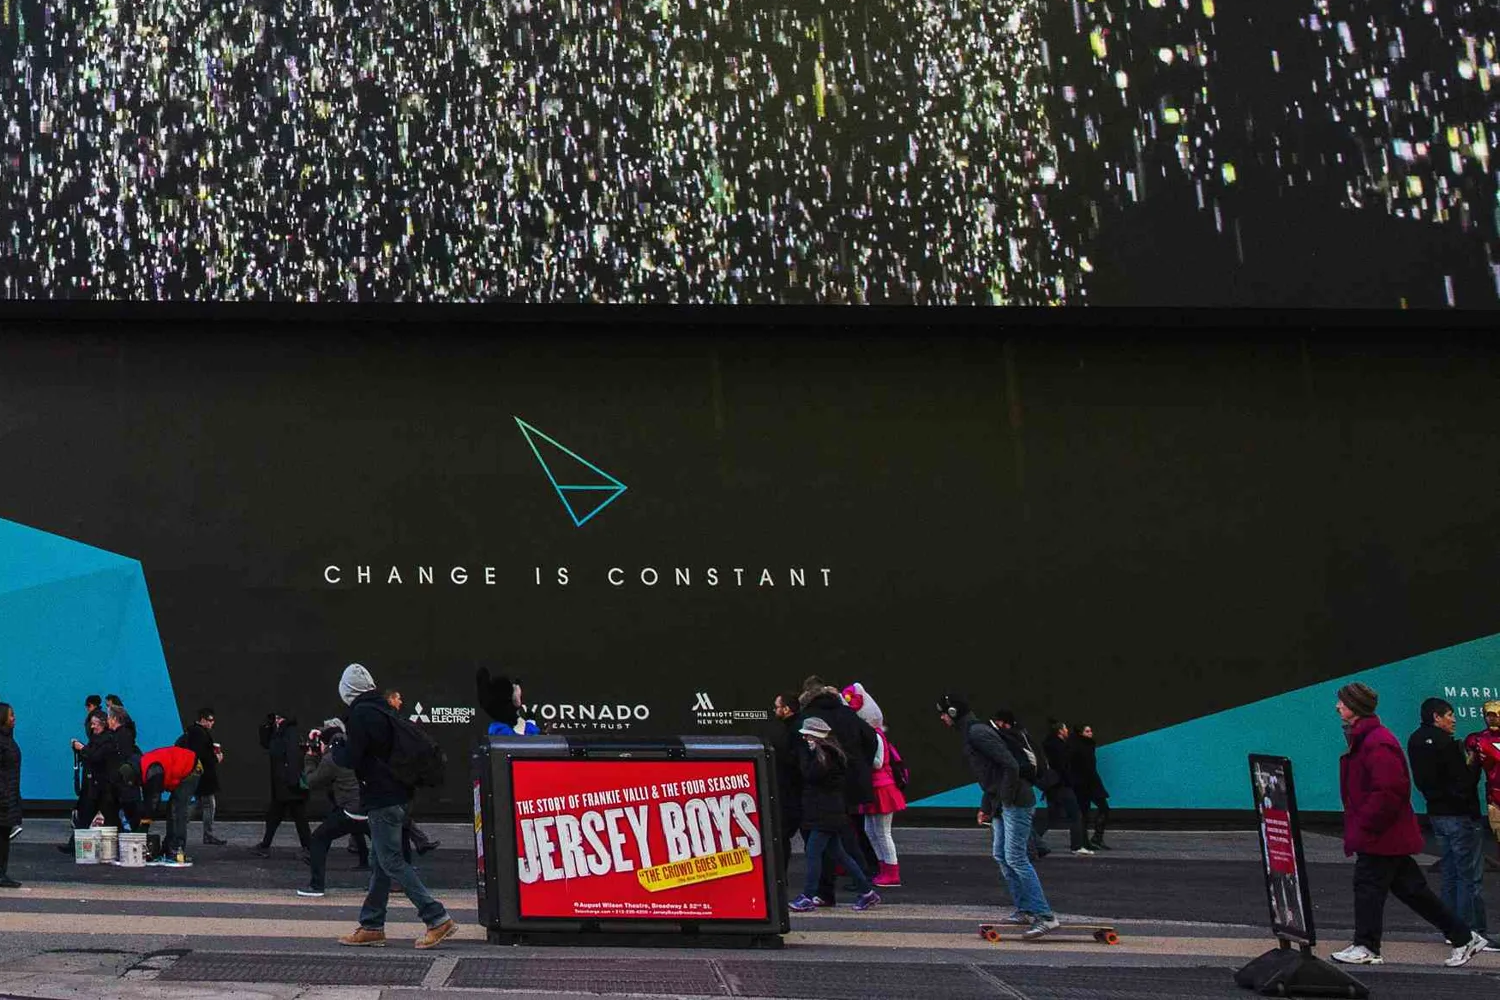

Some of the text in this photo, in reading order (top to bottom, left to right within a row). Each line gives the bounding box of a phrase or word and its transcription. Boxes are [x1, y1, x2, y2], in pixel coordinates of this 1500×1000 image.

[323, 565, 832, 588] CHANGE IS CONSTANT
[431, 707, 476, 716] MITSUBISHI
[431, 715, 470, 724] ELECTRIC
[516, 773, 751, 815] THE STORY OF FRANKIE VALLI & THE FOUR SEASONS
[518, 792, 763, 884] JERSEY BOYS
[662, 861, 694, 880] CROWD
[694, 856, 718, 873] GOES
[579, 901, 601, 909] August
